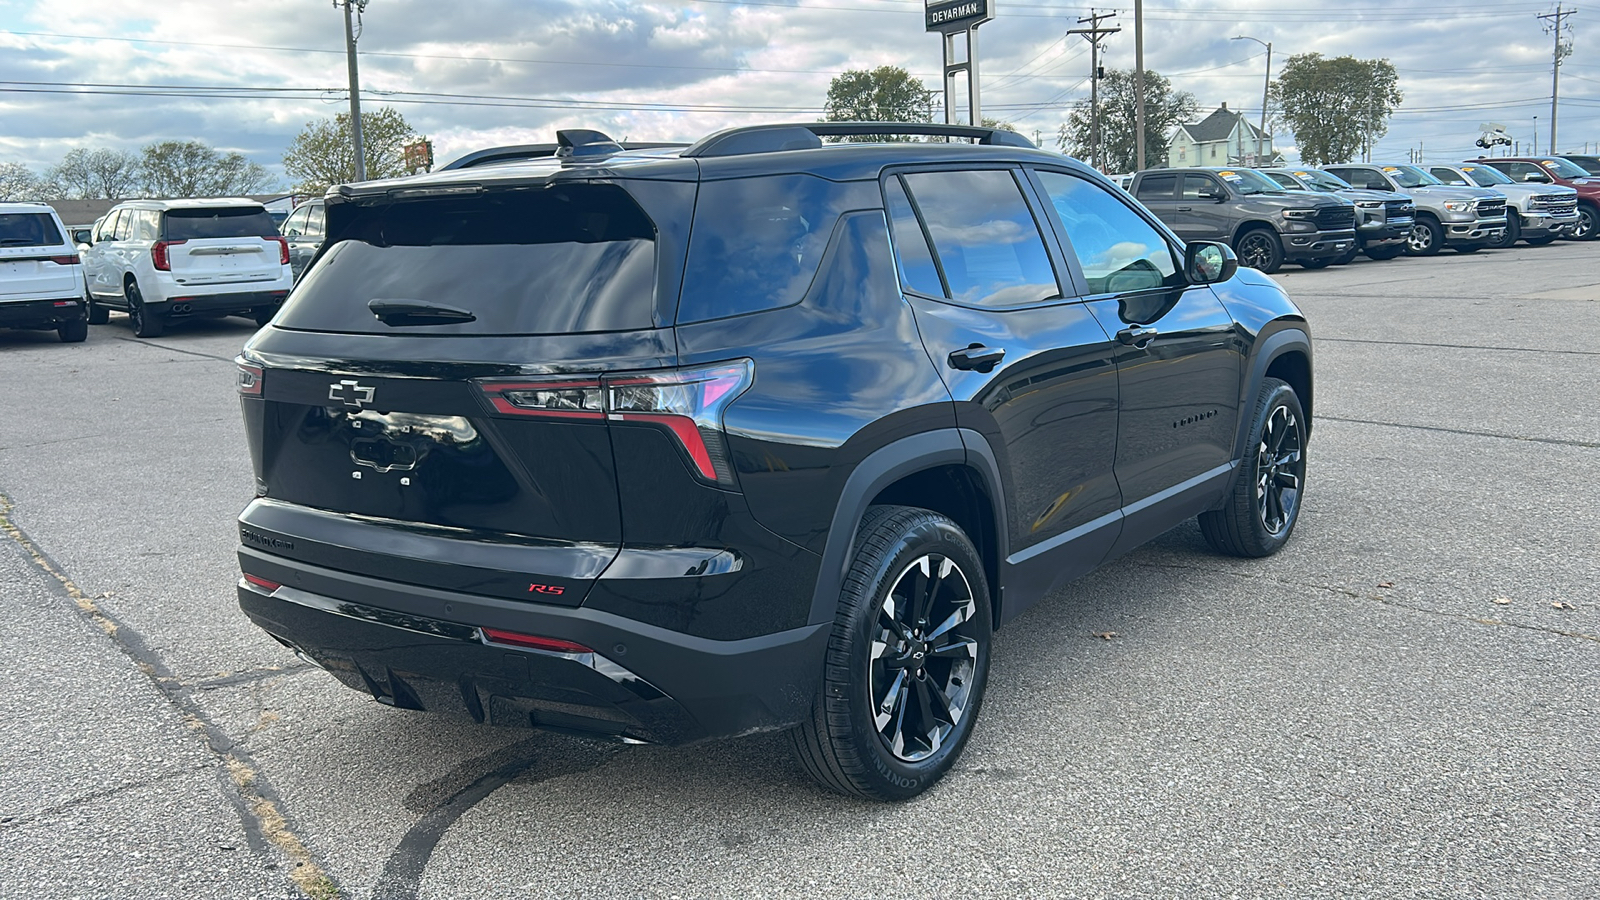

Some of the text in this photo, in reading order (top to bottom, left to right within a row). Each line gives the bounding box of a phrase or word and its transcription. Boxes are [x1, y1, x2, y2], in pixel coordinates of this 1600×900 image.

[932, 3, 977, 23] DEYARMAN
[528, 583, 565, 595] RS
[870, 551, 900, 610] Continental
